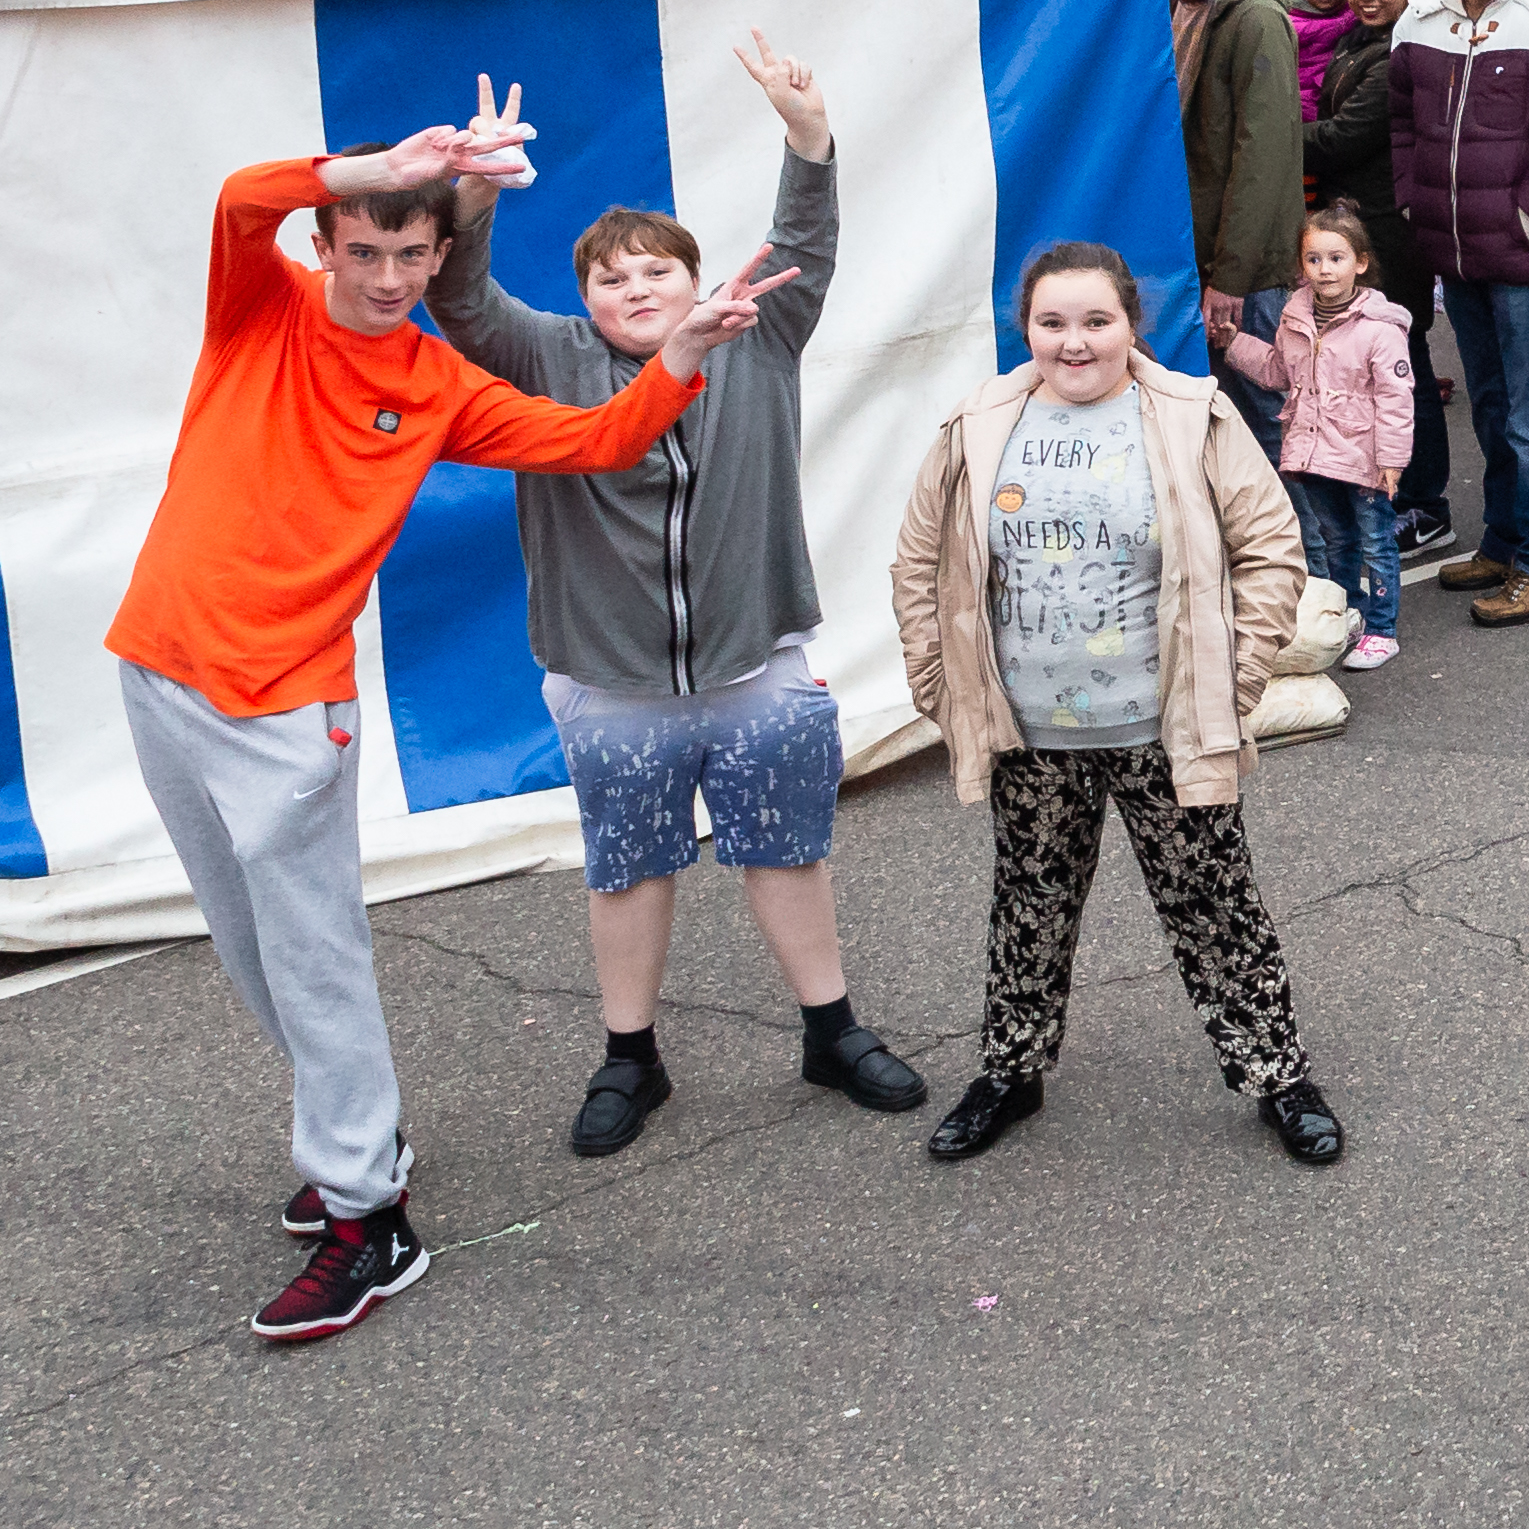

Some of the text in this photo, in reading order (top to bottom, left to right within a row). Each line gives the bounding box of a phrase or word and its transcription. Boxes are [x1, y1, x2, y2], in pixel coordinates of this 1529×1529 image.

[1022, 439, 1100, 469] EVERY
[1003, 520, 1111, 550] NEEDS A
